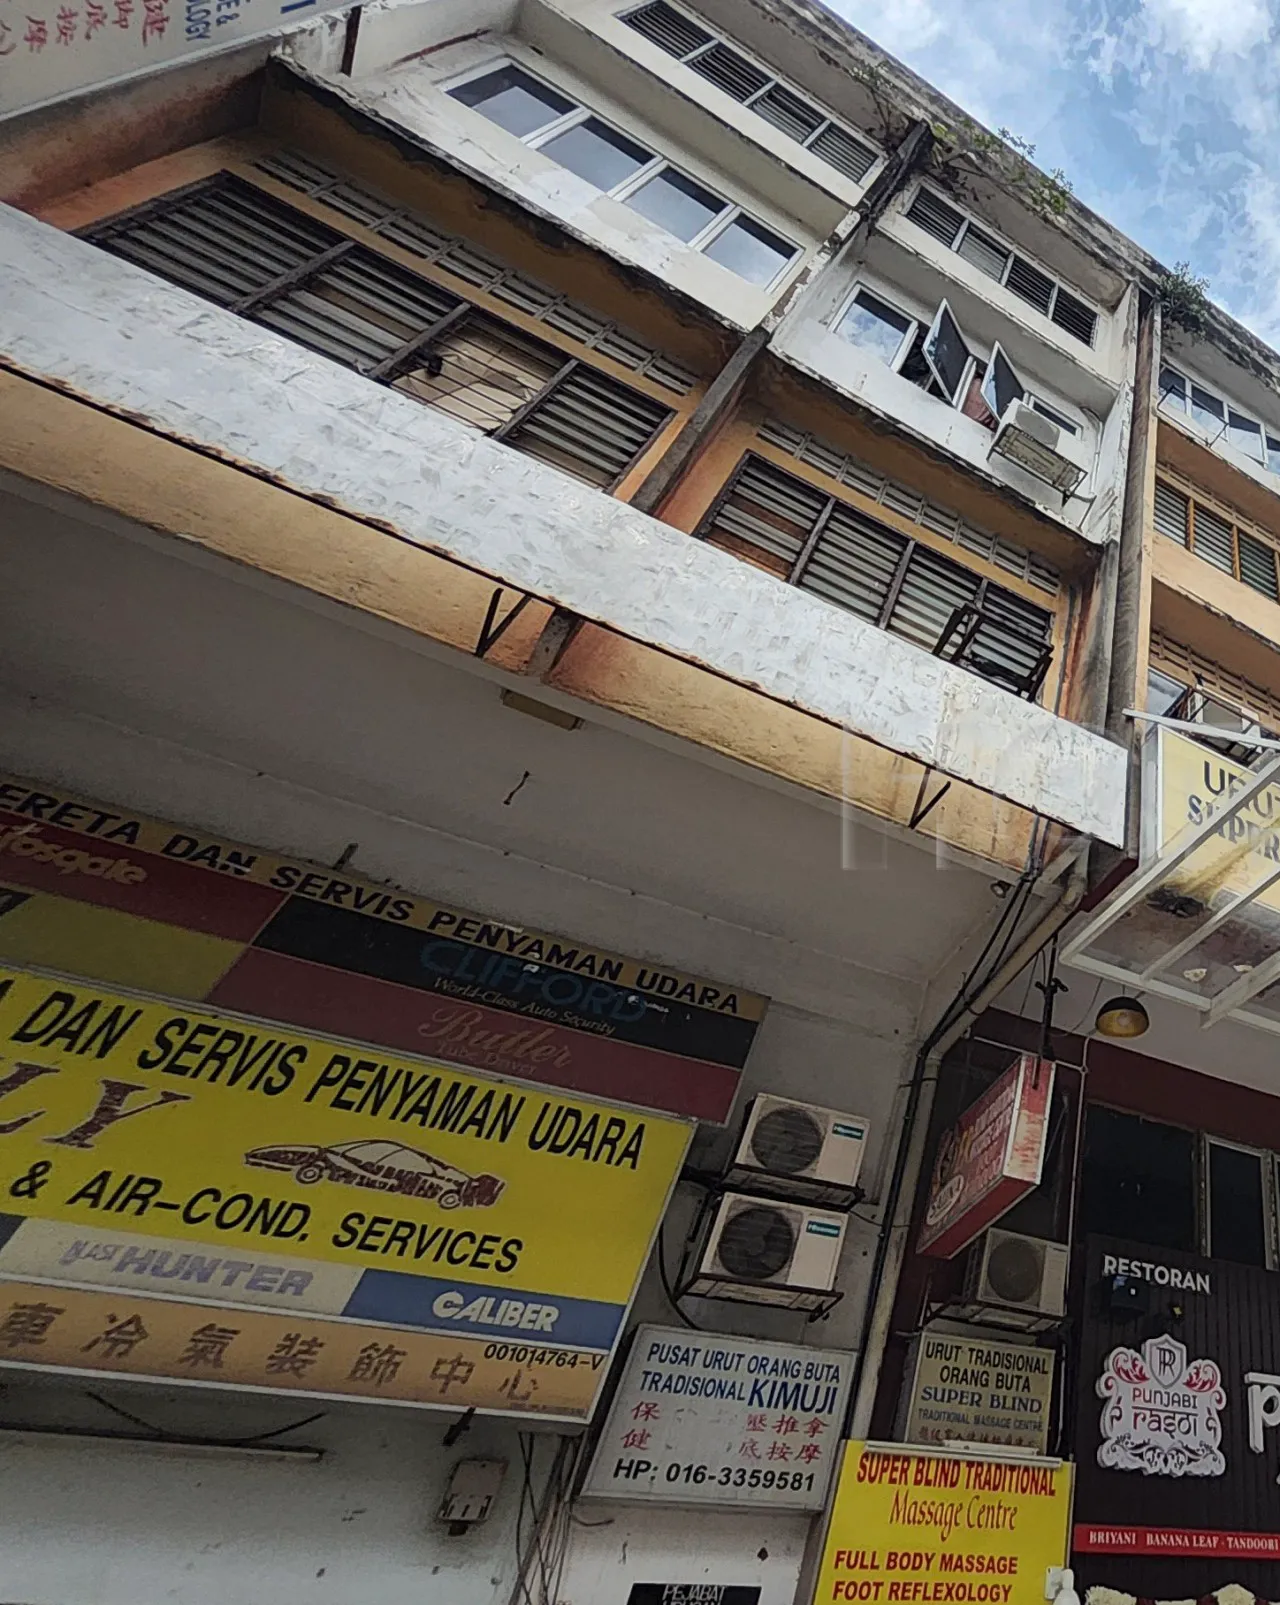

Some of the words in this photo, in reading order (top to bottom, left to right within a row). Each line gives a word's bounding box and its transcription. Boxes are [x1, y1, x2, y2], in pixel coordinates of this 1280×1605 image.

[160, 833, 257, 876] DAN
[269, 865, 415, 922] SERVIS
[427, 910, 624, 983] PENYAMAN
[635, 968, 738, 1014] UDARA
[434, 976, 519, 1010] World-Class
[520, 1003, 557, 1020] Auto
[560, 1011, 616, 1036] Security
[417, 1006, 573, 1069] Butler
[11, 991, 143, 1059] DAN
[137, 1018, 308, 1096] SERVIS
[304, 1054, 526, 1143] PENYAMAN
[528, 1102, 646, 1170] UDARA
[9, 1160, 52, 1199] &
[66, 1170, 311, 1241] AIR-COND.
[332, 1212, 523, 1272] SERVICES
[112, 1246, 315, 1296] HUNTER
[1103, 1254, 1211, 1295] RESTORAN
[432, 1290, 559, 1332] CALIBER
[484, 1343, 605, 1371] 001014764-V
[647, 1343, 702, 1367] PUSAT
[703, 1350, 745, 1373] URUT
[747, 1355, 800, 1377] ORANG
[803, 1362, 840, 1383] BUTA
[925, 1342, 962, 1362] URUT
[968, 1348, 1048, 1374] TRADISIONAL
[640, 1371, 745, 1401] TRADISIONAL
[748, 1379, 838, 1414] KIMUJI
[939, 1365, 990, 1388] ORANG
[995, 1373, 1031, 1393] BUTA
[1132, 1388, 1198, 1409] PUNJABI
[918, 1408, 970, 1425] TRADITIONAL
[973, 1414, 1011, 1429] MASSAGE
[921, 1386, 982, 1408] SUPER
[989, 1394, 1042, 1413] BLIND
[613, 1458, 658, 1481] HP:
[666, 1463, 815, 1491] 016-3359581
[857, 1452, 910, 1486] SUPER
[913, 1456, 961, 1489] BLIND
[965, 1461, 1056, 1497] TRADITIONAL
[889, 1489, 961, 1542] Massage
[966, 1495, 1018, 1530] Centre
[1089, 1531, 1136, 1545] BRIYANI
[1146, 1533, 1190, 1547] BANANA
[1193, 1535, 1219, 1548] LEAF
[1227, 1537, 1278, 1551] TANDOORI
[834, 1550, 880, 1570] FULL
[886, 1551, 935, 1572] BODY
[939, 1554, 1018, 1574] MASSAGE
[832, 1580, 883, 1601] FOOT
[887, 1582, 1013, 1603] REFLEXOLOGY
